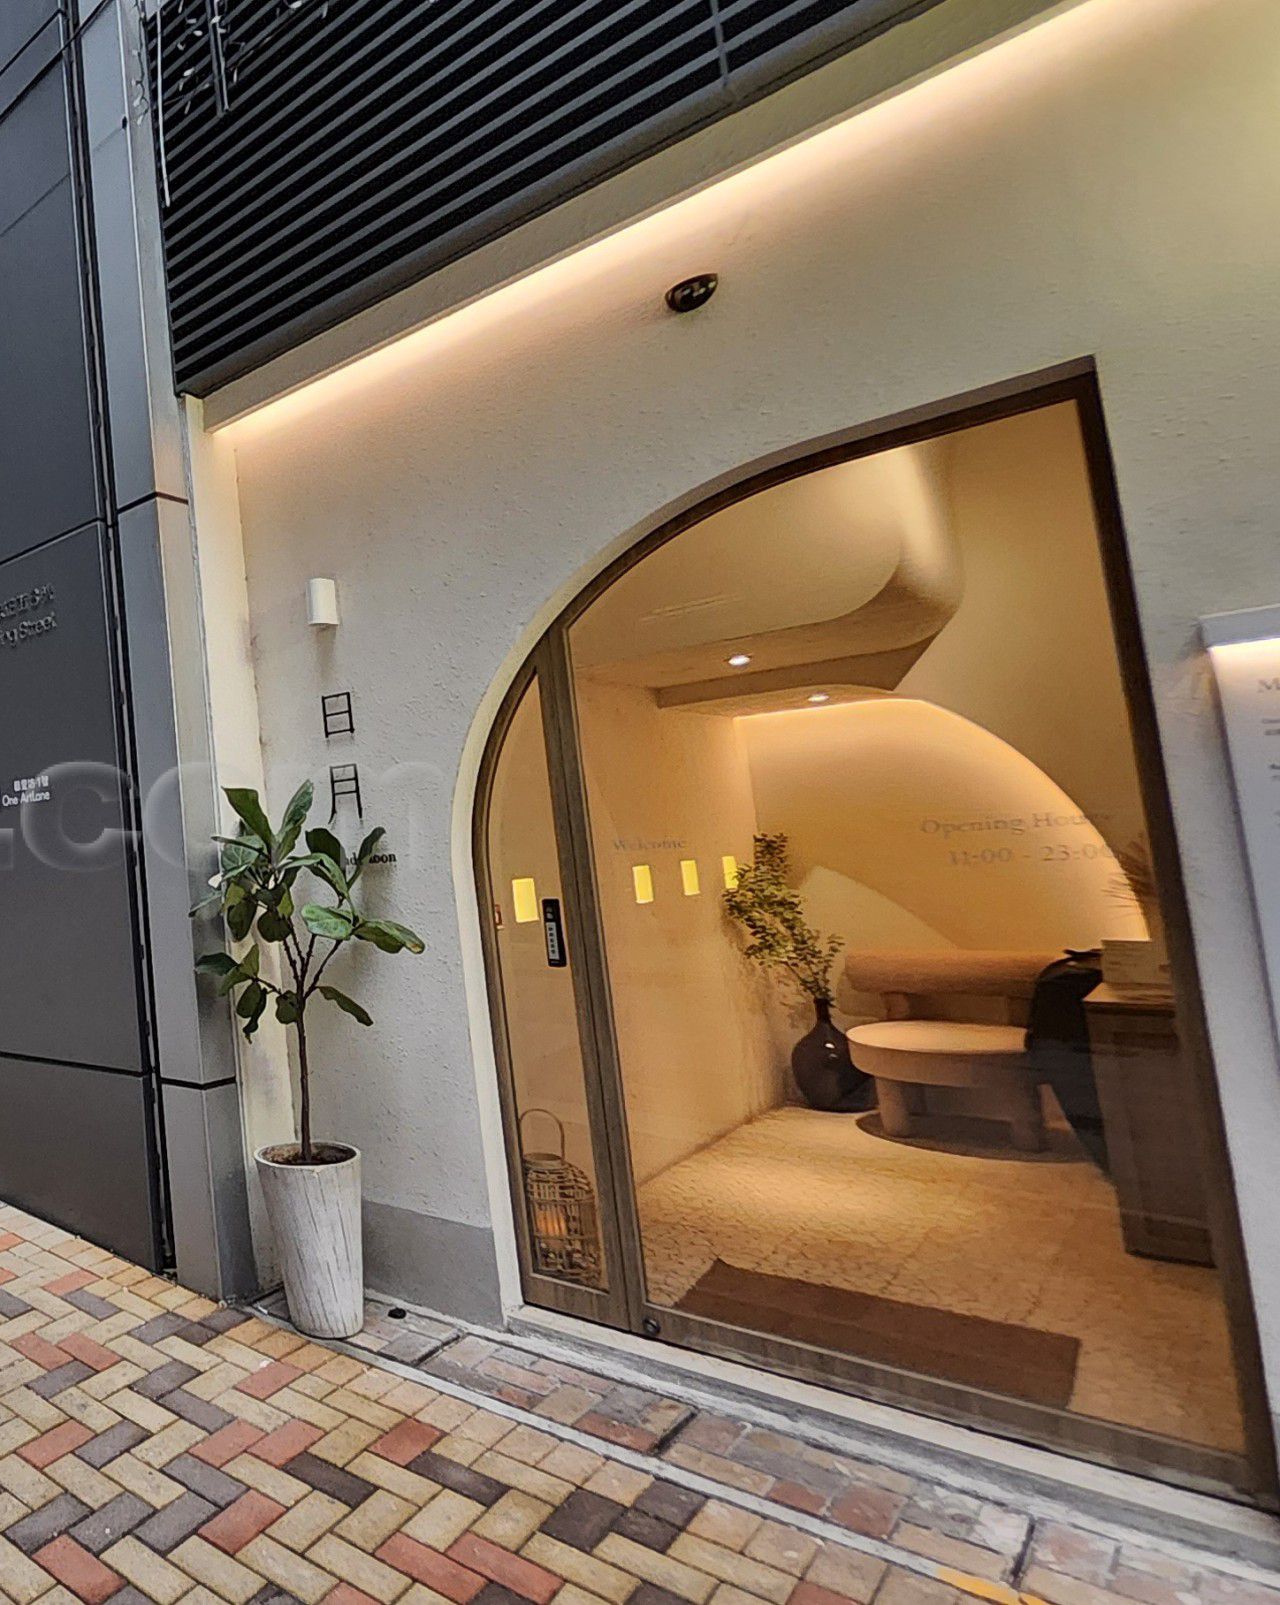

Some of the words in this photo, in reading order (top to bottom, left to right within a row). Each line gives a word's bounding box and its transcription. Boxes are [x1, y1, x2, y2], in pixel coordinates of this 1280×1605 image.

[19, 611, 57, 640] Street
[2, 794, 19, 807] One
[921, 813, 1024, 838] Opening
